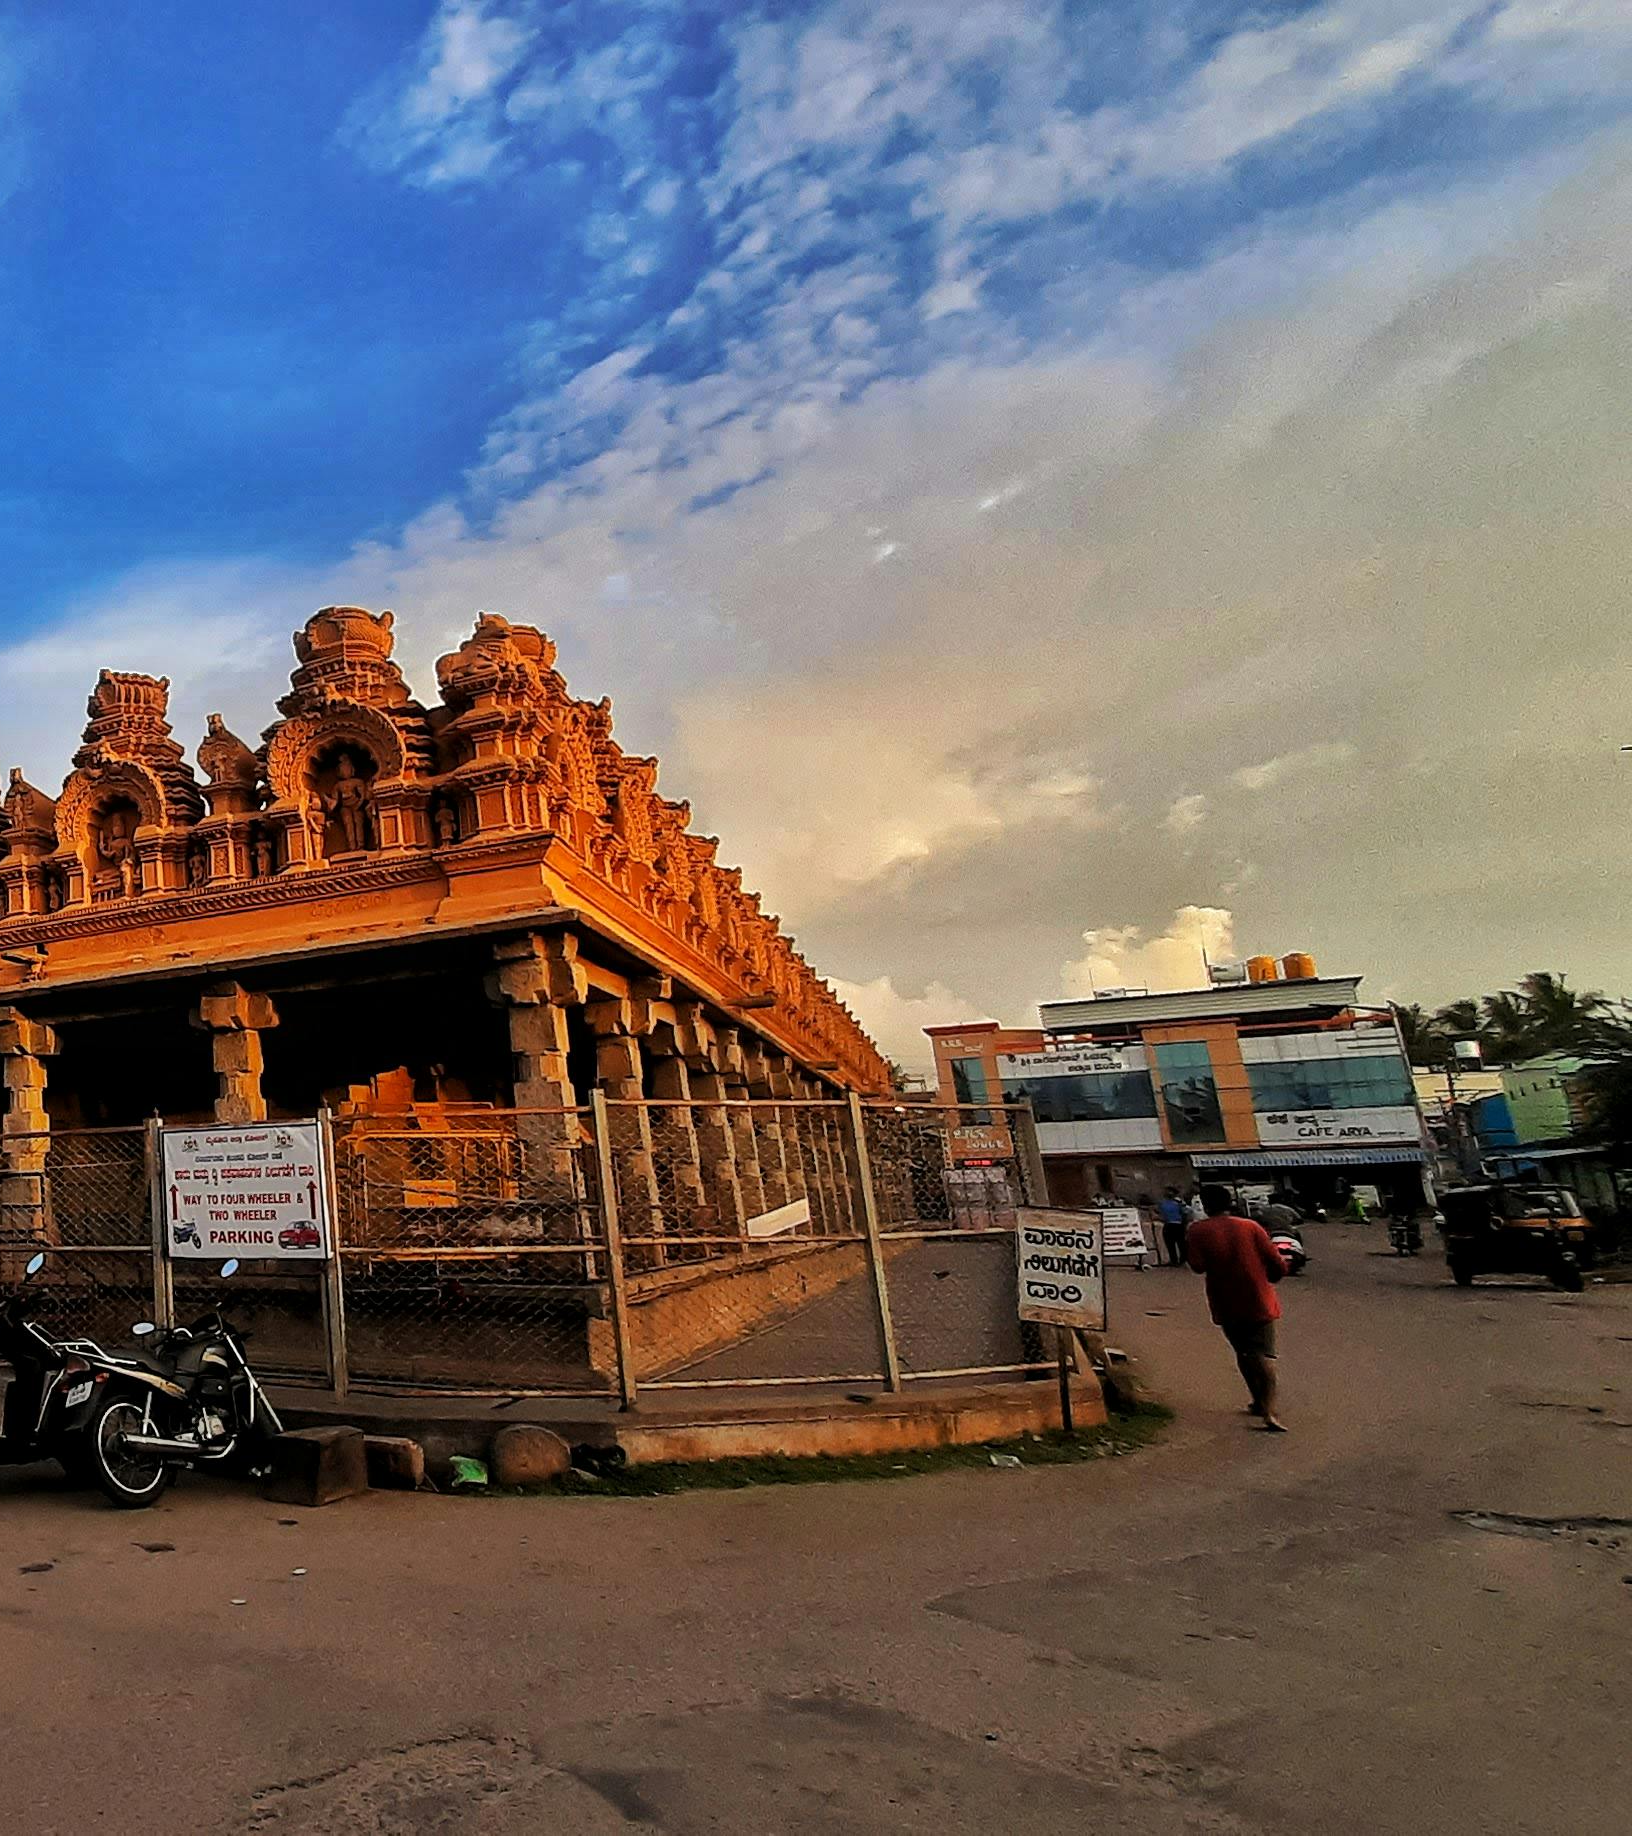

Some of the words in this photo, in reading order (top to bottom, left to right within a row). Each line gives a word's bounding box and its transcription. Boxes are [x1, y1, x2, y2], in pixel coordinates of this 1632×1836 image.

[1298, 1127, 1334, 1137] CAFE
[1338, 1126, 1373, 1137] ARYA
[183, 1194, 202, 1205] WAY
[207, 1194, 219, 1205] TO
[221, 1194, 246, 1205] FOUR
[248, 1193, 291, 1205] WHEELER
[297, 1193, 303, 1204] &
[209, 1210, 229, 1221] TWO
[234, 1210, 277, 1221] WHEELER
[210, 1231, 274, 1244] PARKING
[1023, 1226, 1094, 1250] ವಾಹನ
[1024, 1253, 1099, 1278] ನಿಲುಗಡೆಗೆ
[1025, 1280, 1083, 1304] ದಾರಿ
